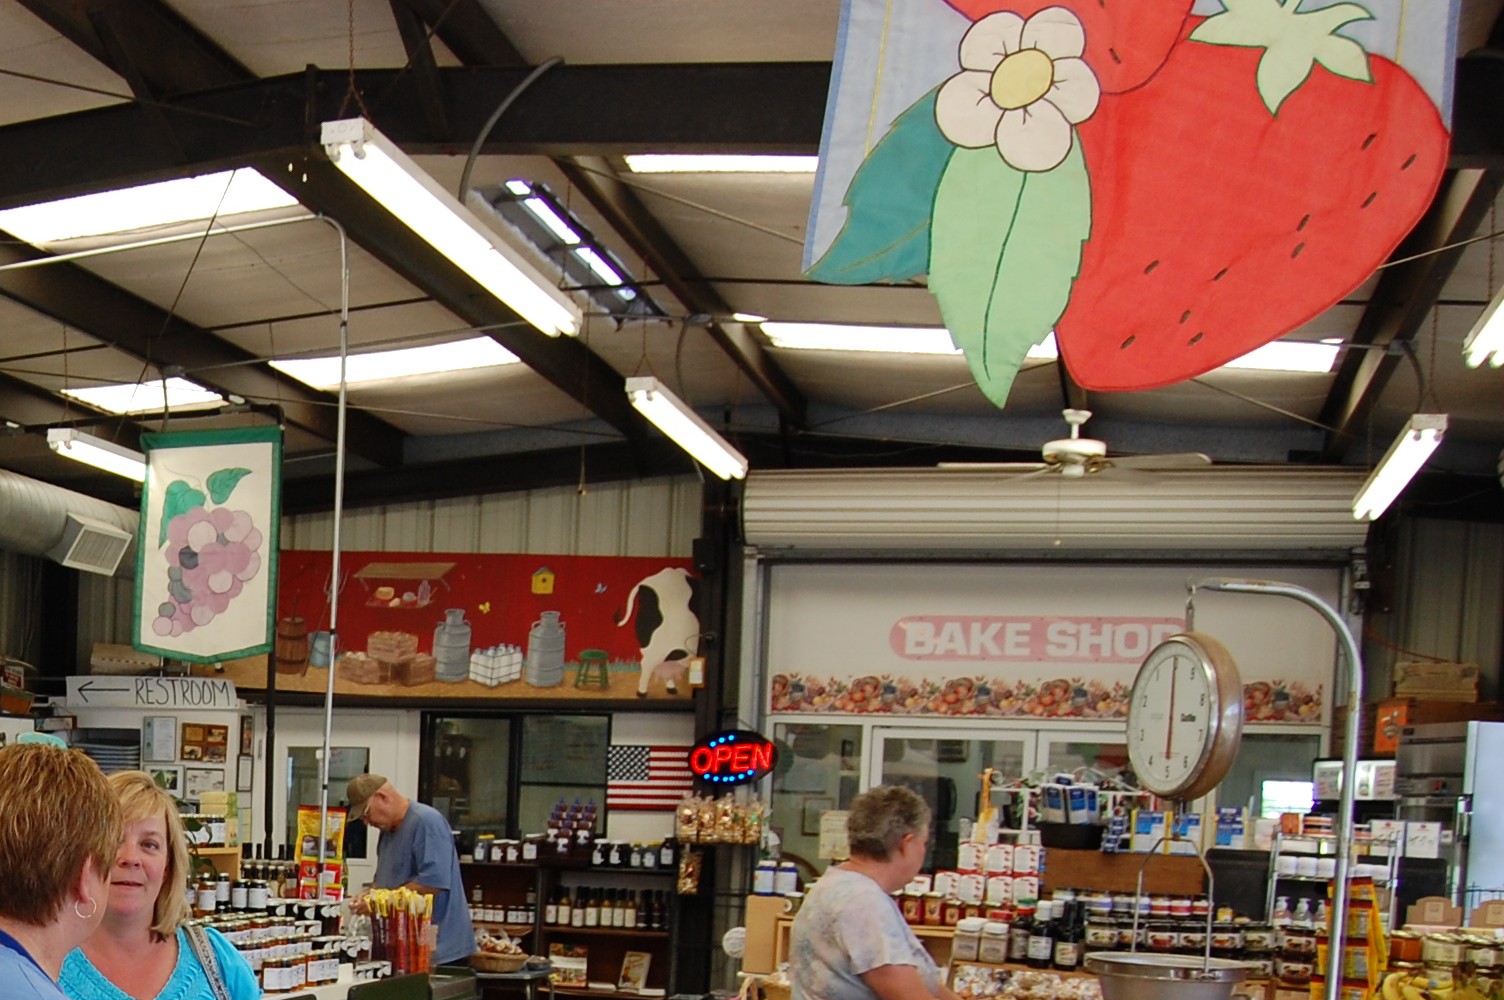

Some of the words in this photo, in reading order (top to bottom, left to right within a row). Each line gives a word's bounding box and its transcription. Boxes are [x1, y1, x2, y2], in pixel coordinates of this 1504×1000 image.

[904, 622, 1033, 656] BAKE
[135, 678, 231, 706] RESTROOM
[691, 742, 773, 774] OPEN
